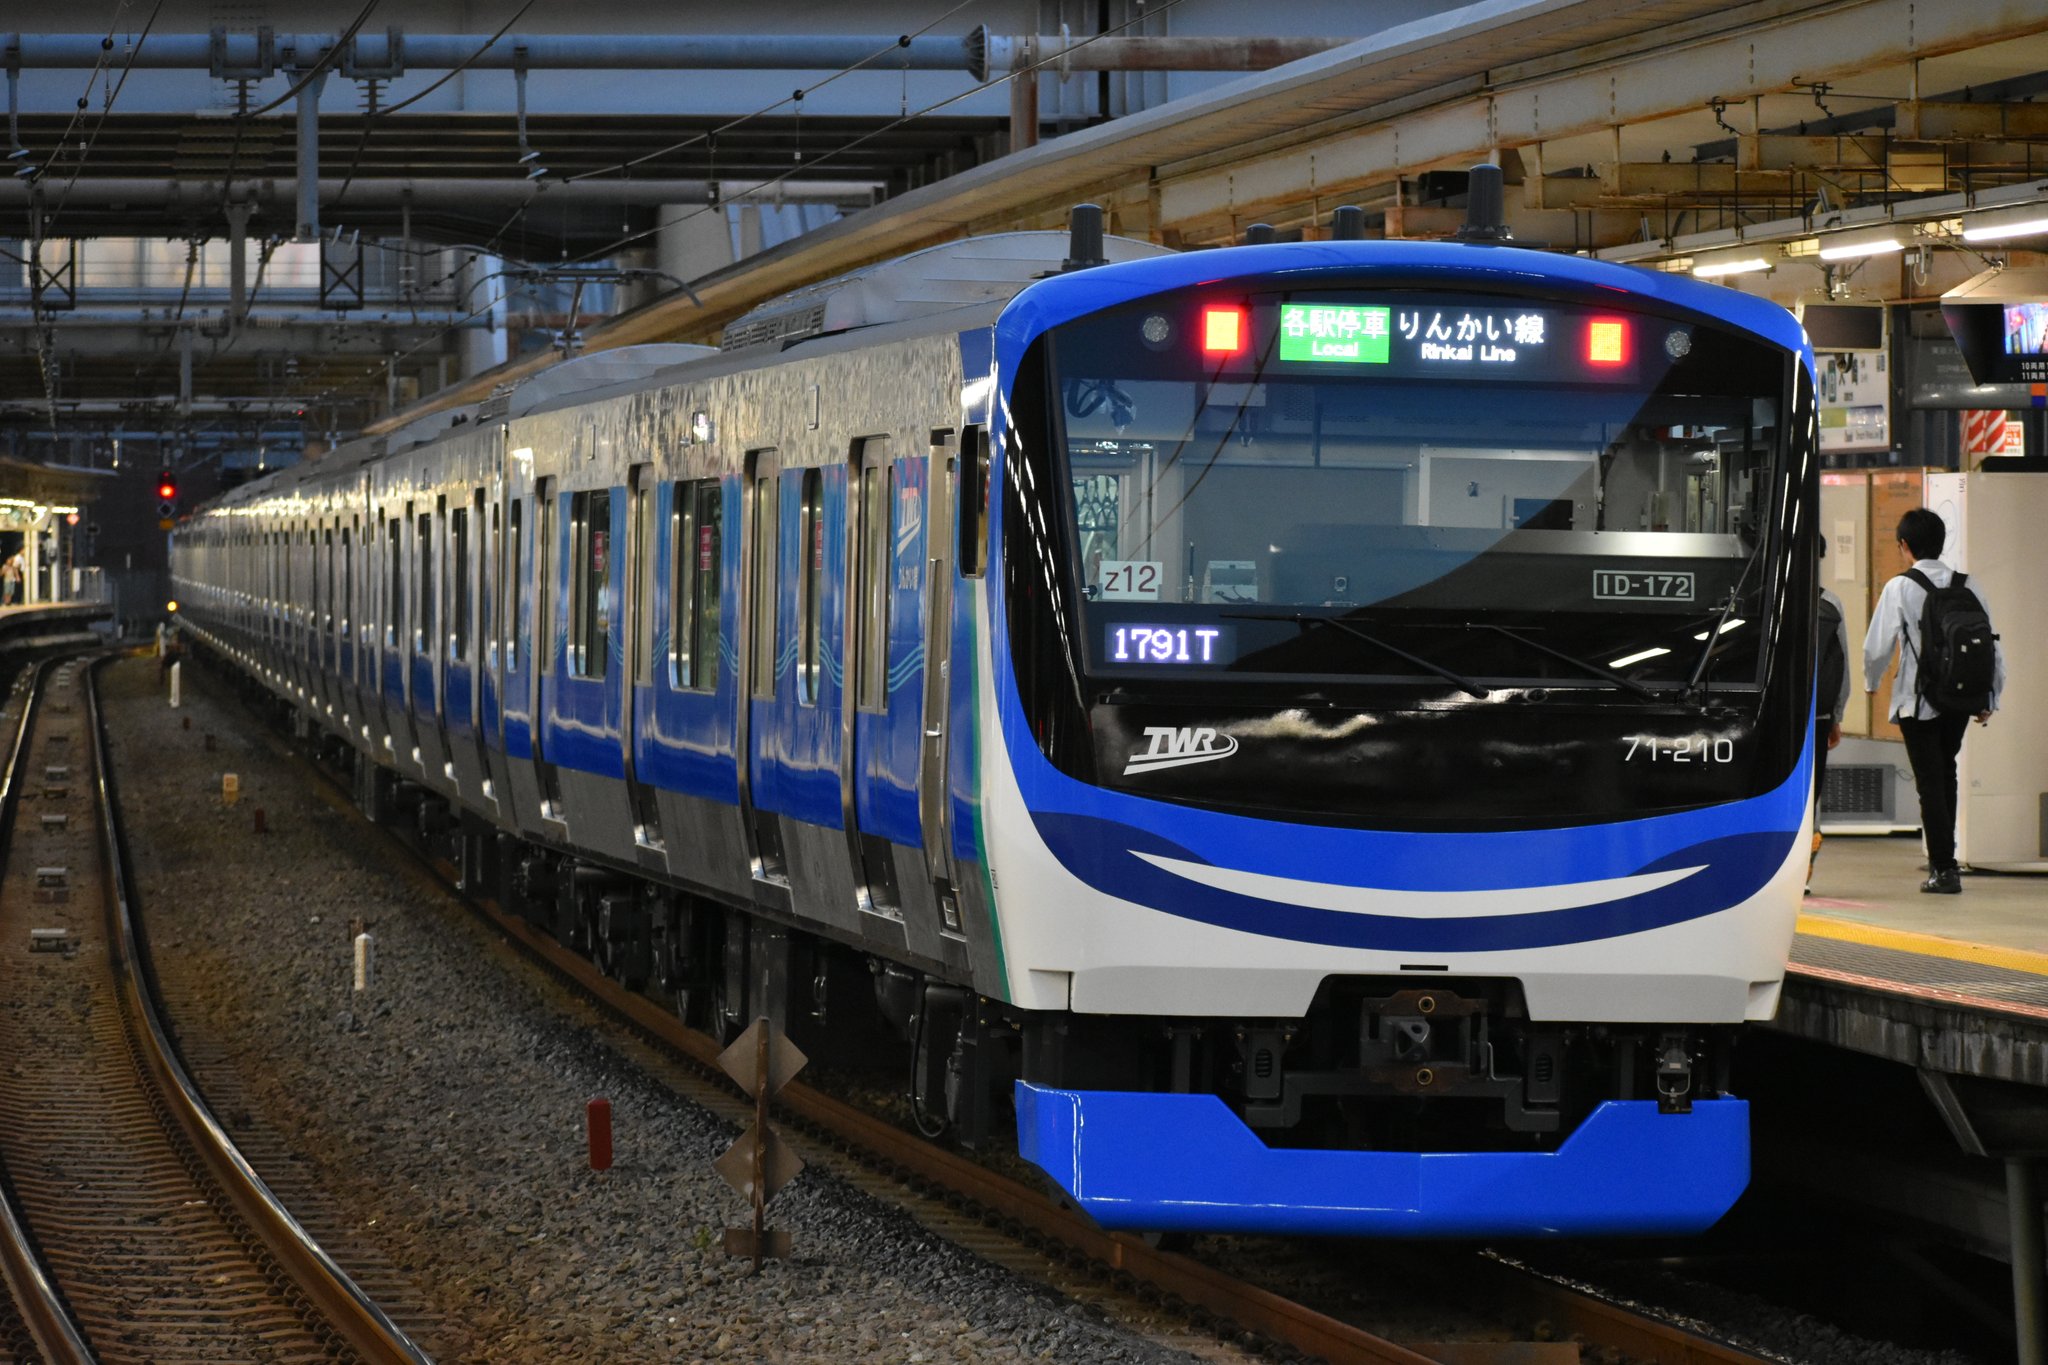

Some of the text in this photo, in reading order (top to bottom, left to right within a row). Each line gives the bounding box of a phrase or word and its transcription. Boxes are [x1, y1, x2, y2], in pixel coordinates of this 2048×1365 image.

[1284, 308, 1388, 339] 各駅停車
[1398, 311, 1546, 345] りんかい線
[1312, 341, 1359, 357] Local
[1421, 343, 1516, 363] Rinkai Line
[1602, 574, 1690, 598] ID-172
[1114, 627, 1219, 661] 1791T
[1622, 736, 1733, 764] 71-210
